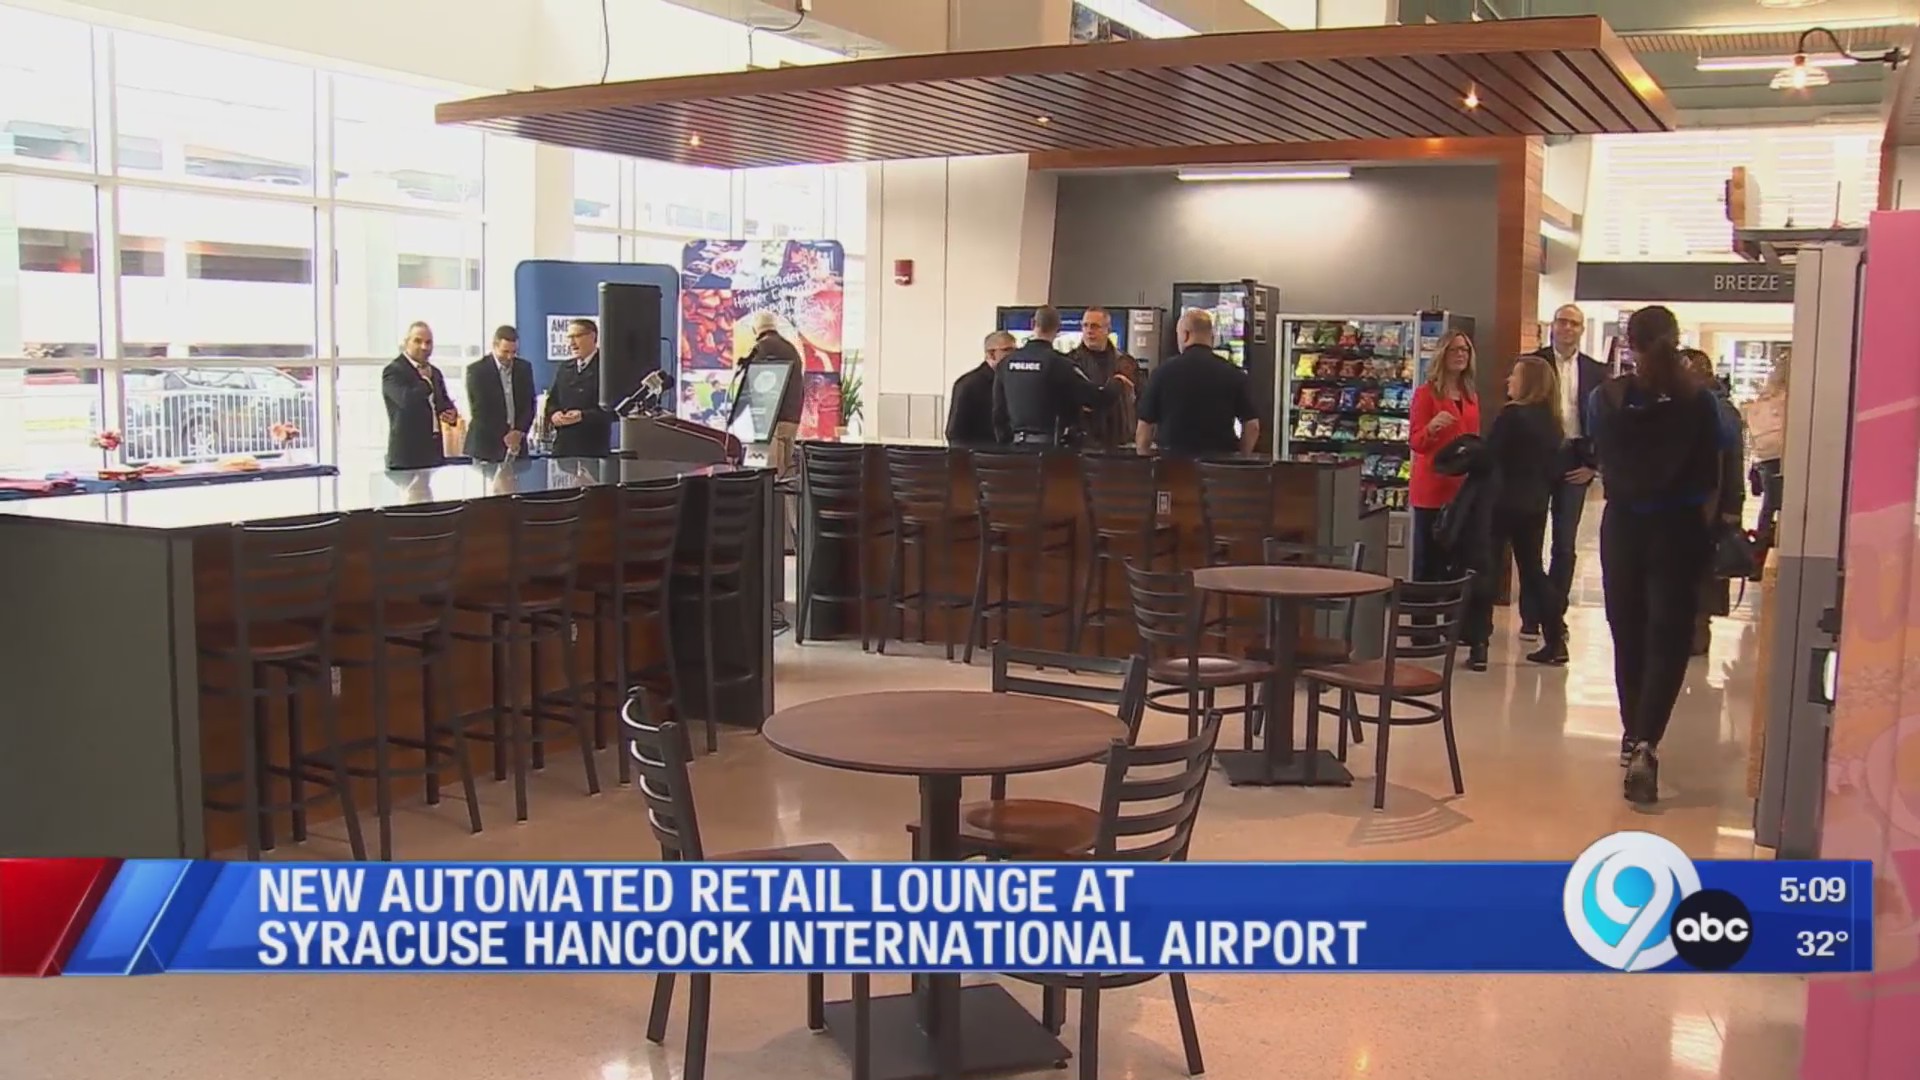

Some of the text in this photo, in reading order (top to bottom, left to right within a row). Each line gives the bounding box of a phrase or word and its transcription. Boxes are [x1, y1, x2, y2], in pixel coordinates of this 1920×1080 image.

[1714, 274, 1779, 291] BREEZE
[734, 293, 768, 308] Higher
[1008, 362, 1042, 372] POLICE
